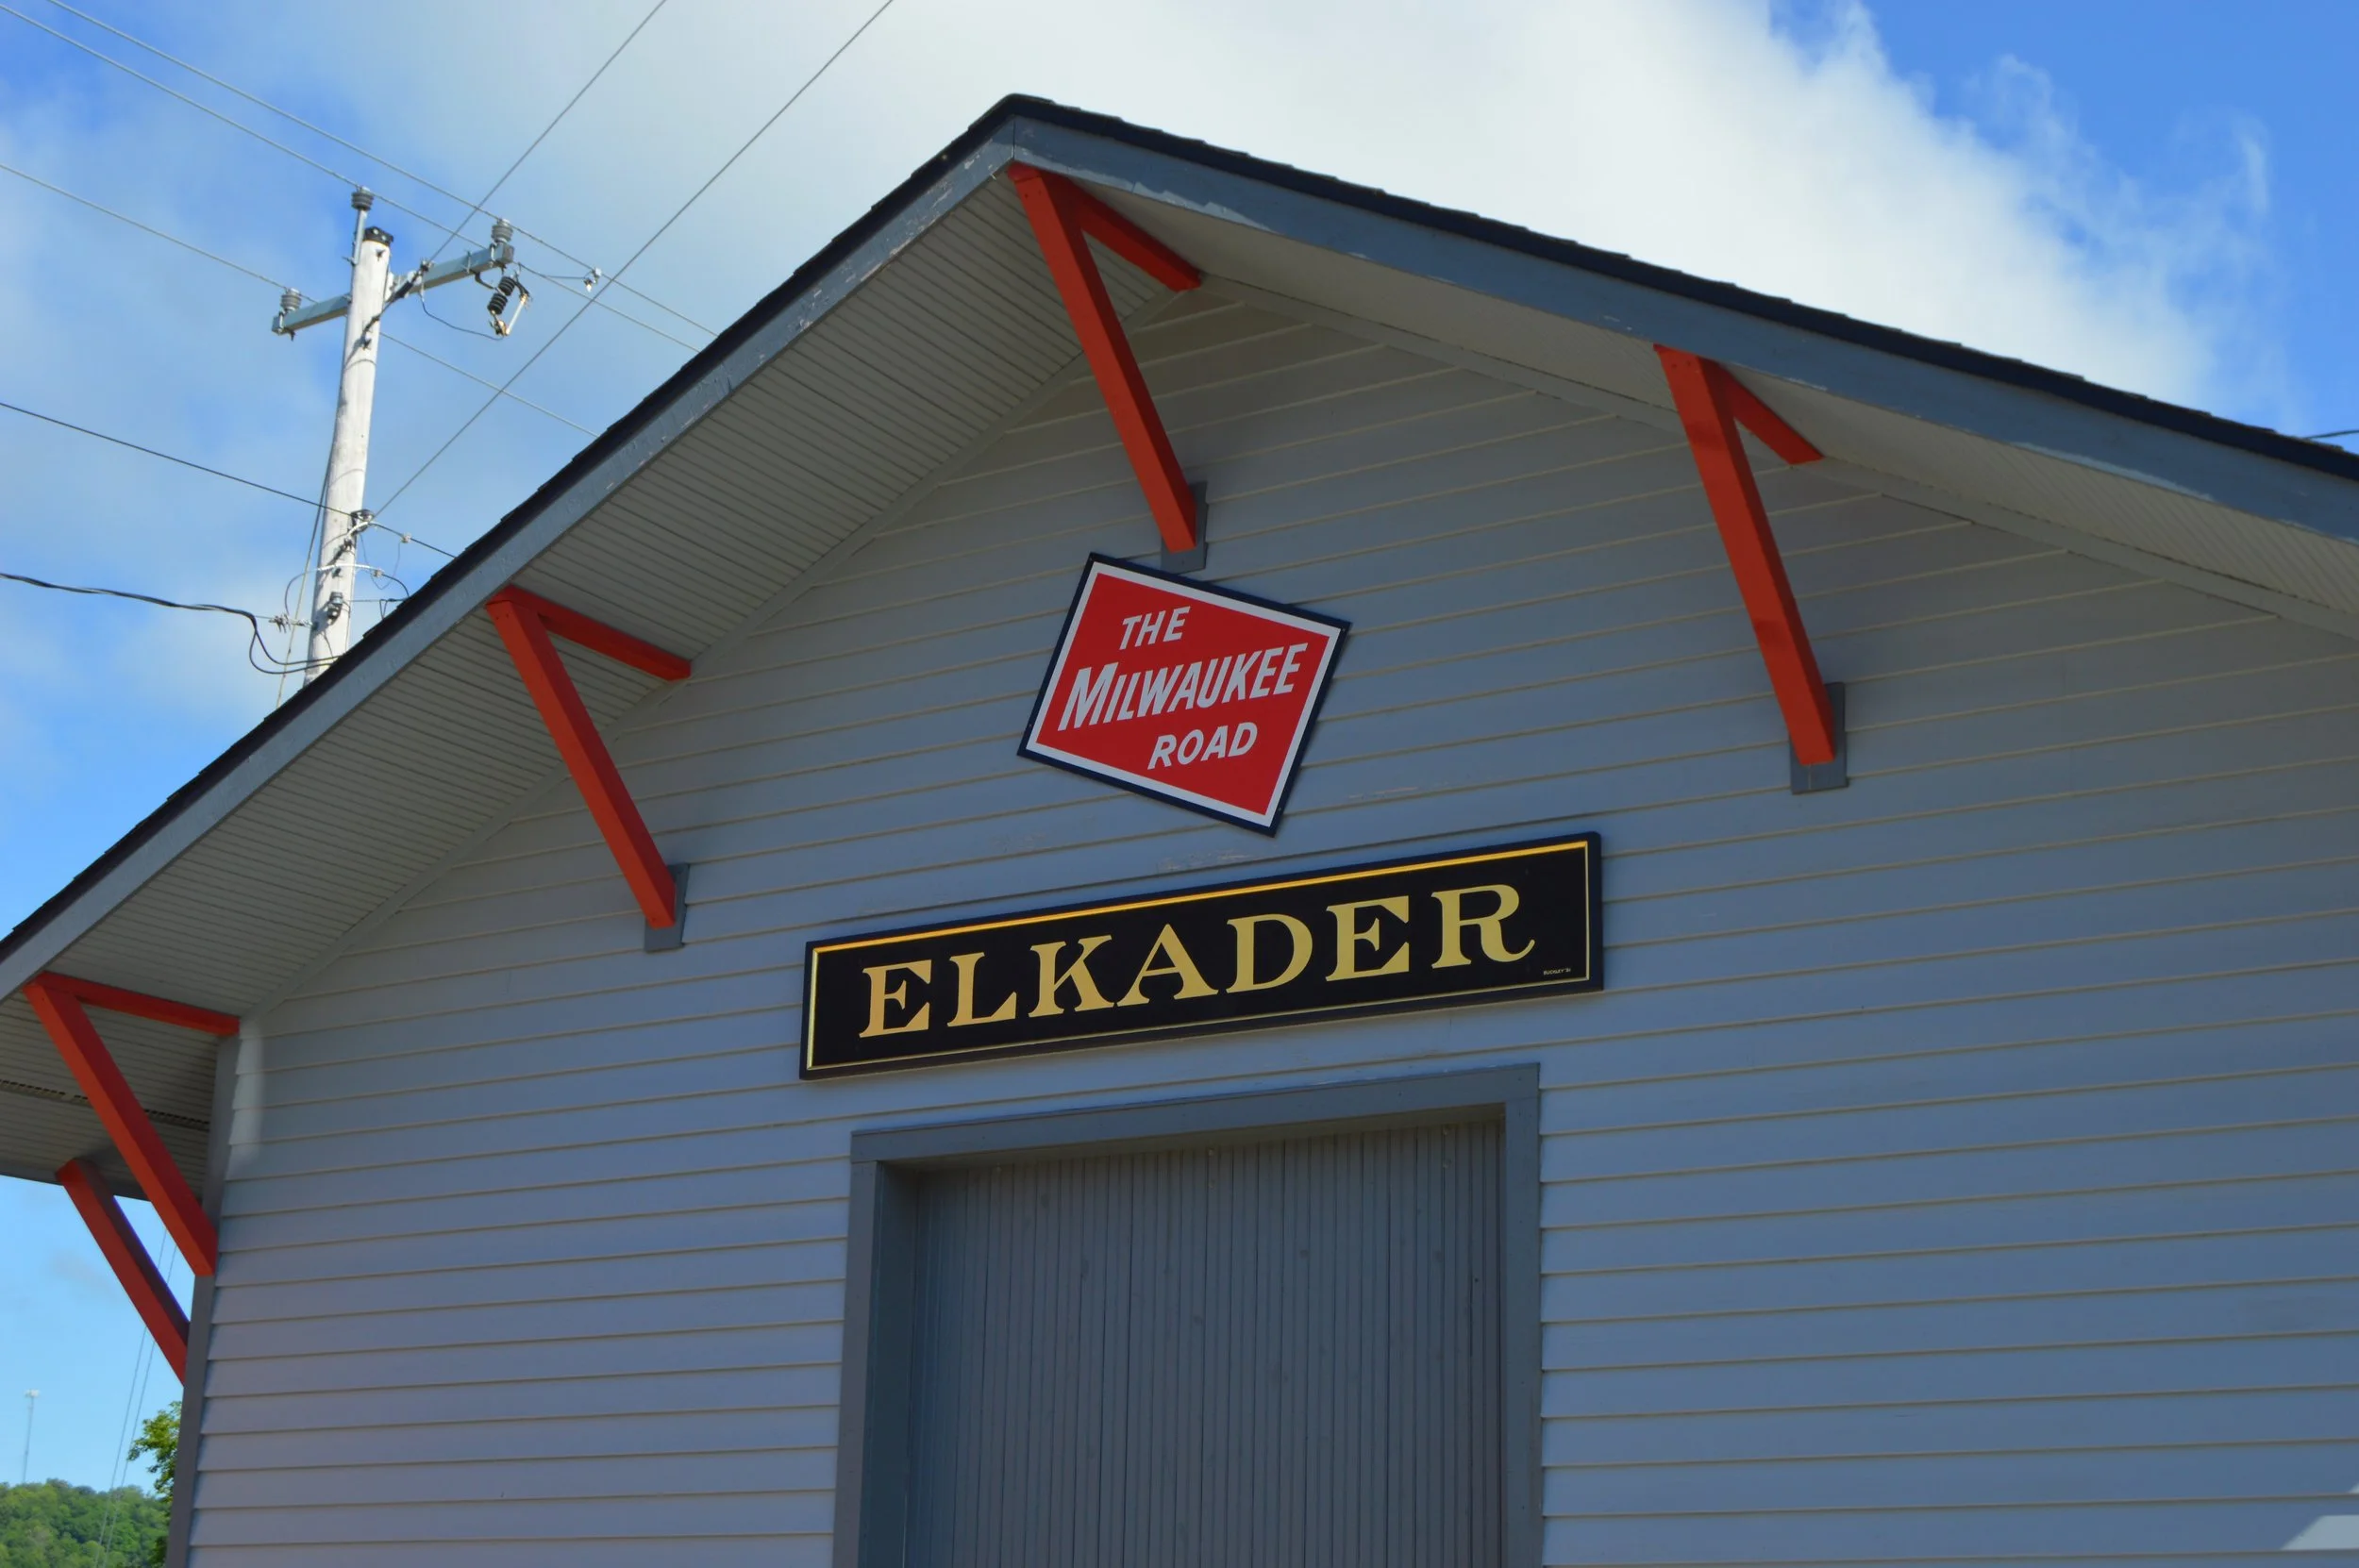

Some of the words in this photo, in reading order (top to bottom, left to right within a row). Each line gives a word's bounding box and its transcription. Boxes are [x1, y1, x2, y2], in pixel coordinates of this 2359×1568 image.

[1120, 607, 1190, 649] THE
[1058, 643, 1308, 730] MILWAUKEE
[1147, 723, 1257, 769] ROAD
[860, 885, 1534, 1038] ELKADER
